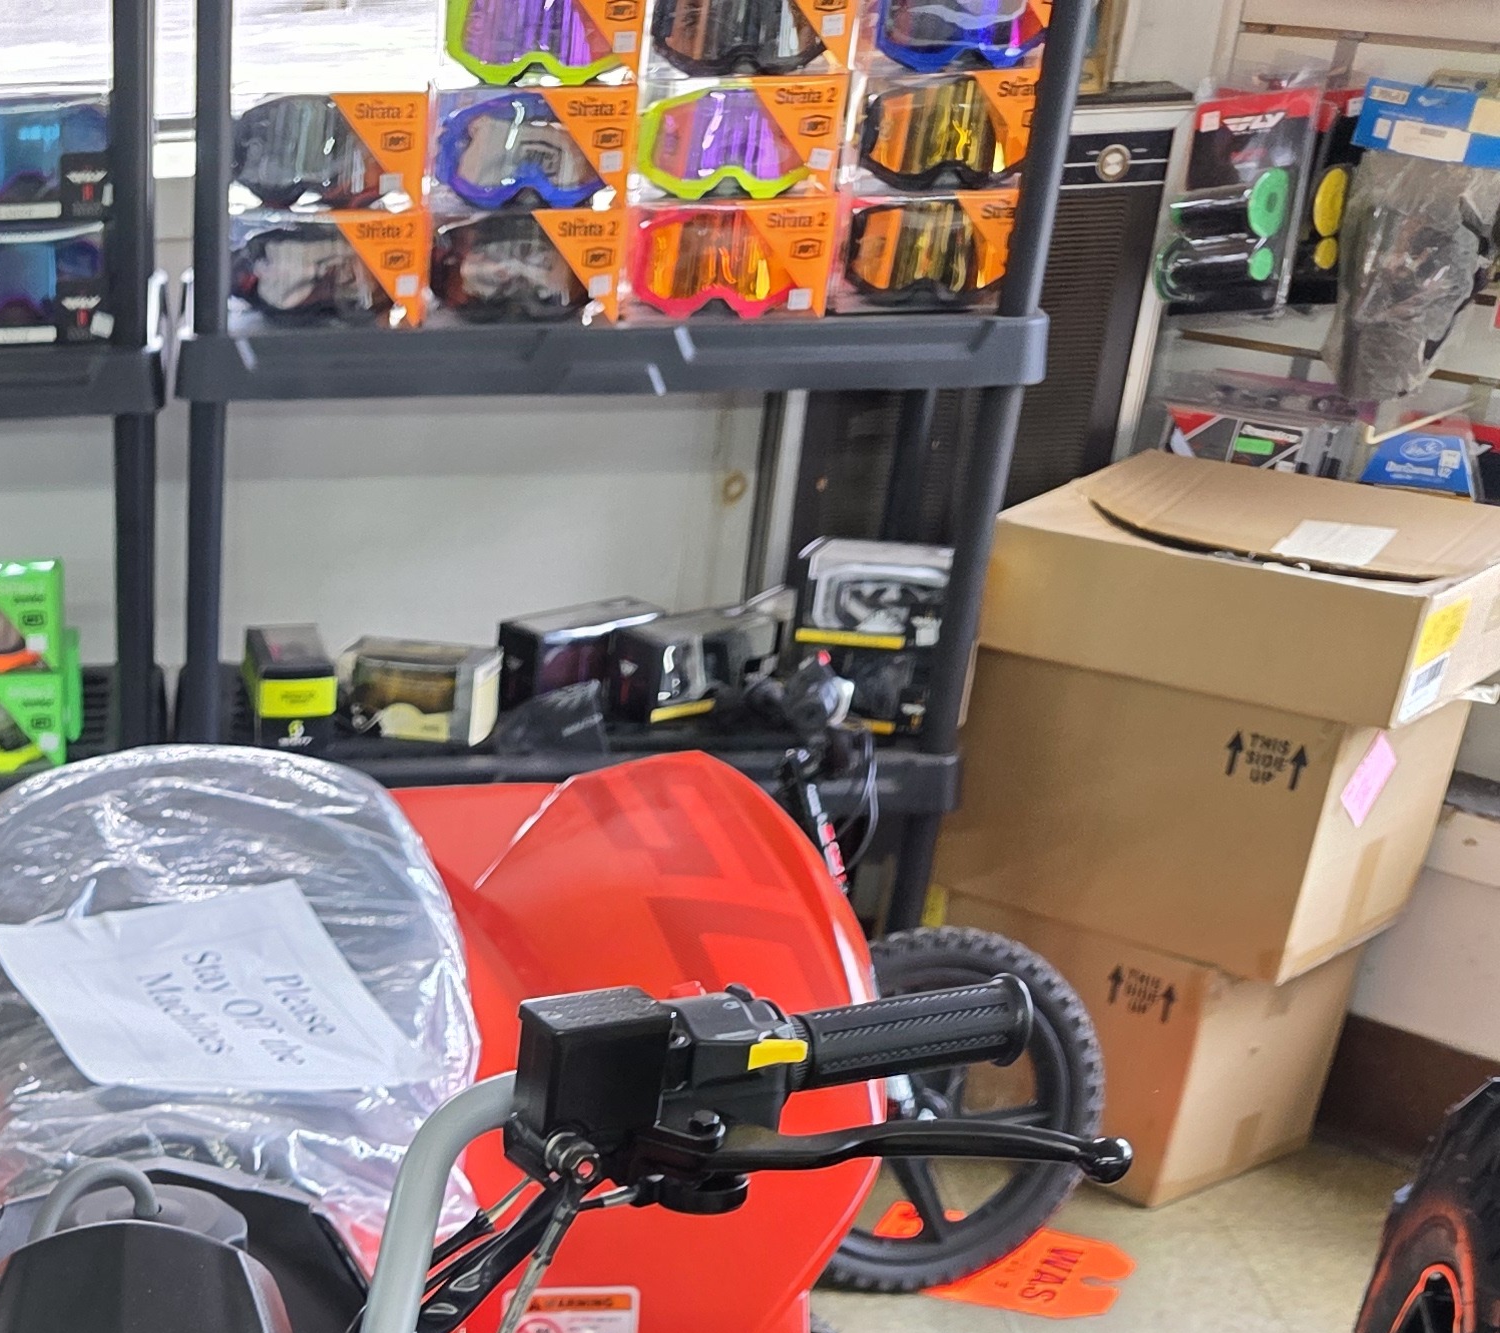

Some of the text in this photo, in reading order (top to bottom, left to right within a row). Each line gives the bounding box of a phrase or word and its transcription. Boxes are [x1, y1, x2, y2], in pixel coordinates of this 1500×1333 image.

[826, 87, 838, 103] 2
[405, 102, 416, 119] 2
[567, 99, 629, 117] Strata 2
[557, 219, 618, 238] Strata 2
[817, 211, 828, 228] 2
[404, 221, 414, 238] 2
[1249, 733, 1290, 756] THIS
[1245, 750, 1286, 773] SIDE
[1249, 770, 1274, 785] UP
[137, 970, 230, 1056] Machines
[182, 950, 306, 1067] Stay Off the
[263, 971, 337, 1036] Please
[1020, 1247, 1086, 1303] WAS
